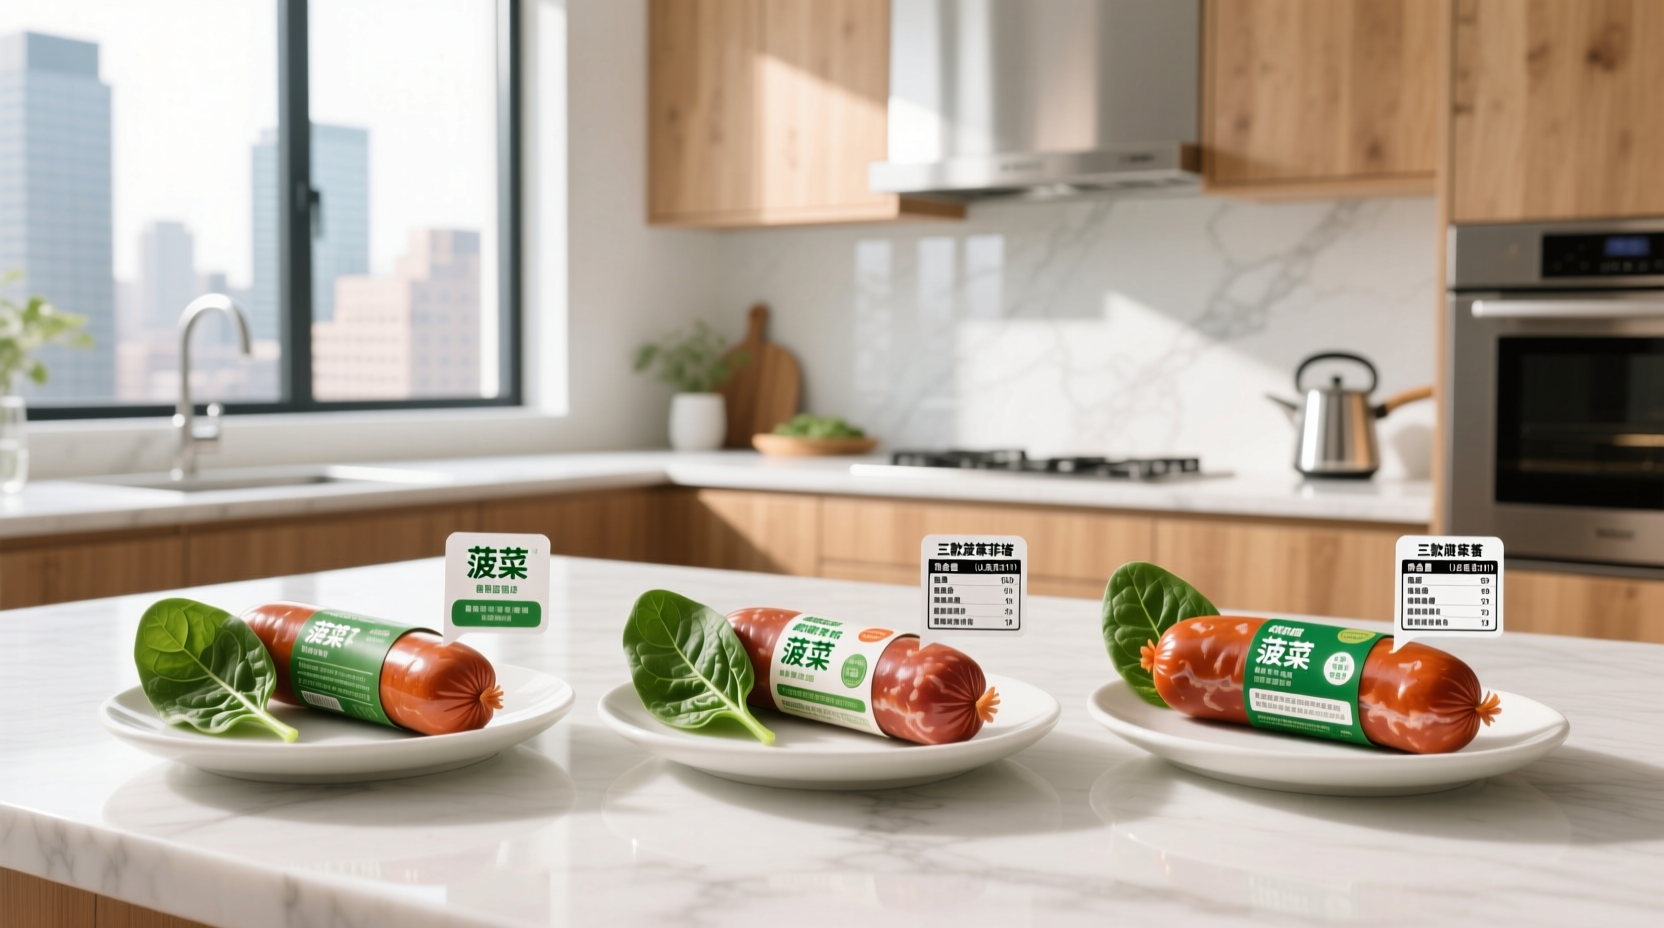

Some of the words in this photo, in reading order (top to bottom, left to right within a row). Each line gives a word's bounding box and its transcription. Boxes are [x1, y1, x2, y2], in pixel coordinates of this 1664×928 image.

[467, 545, 528, 580] 菠菜
[780, 636, 835, 671] 菠菜
[1256, 636, 1315, 670] 菠菜
